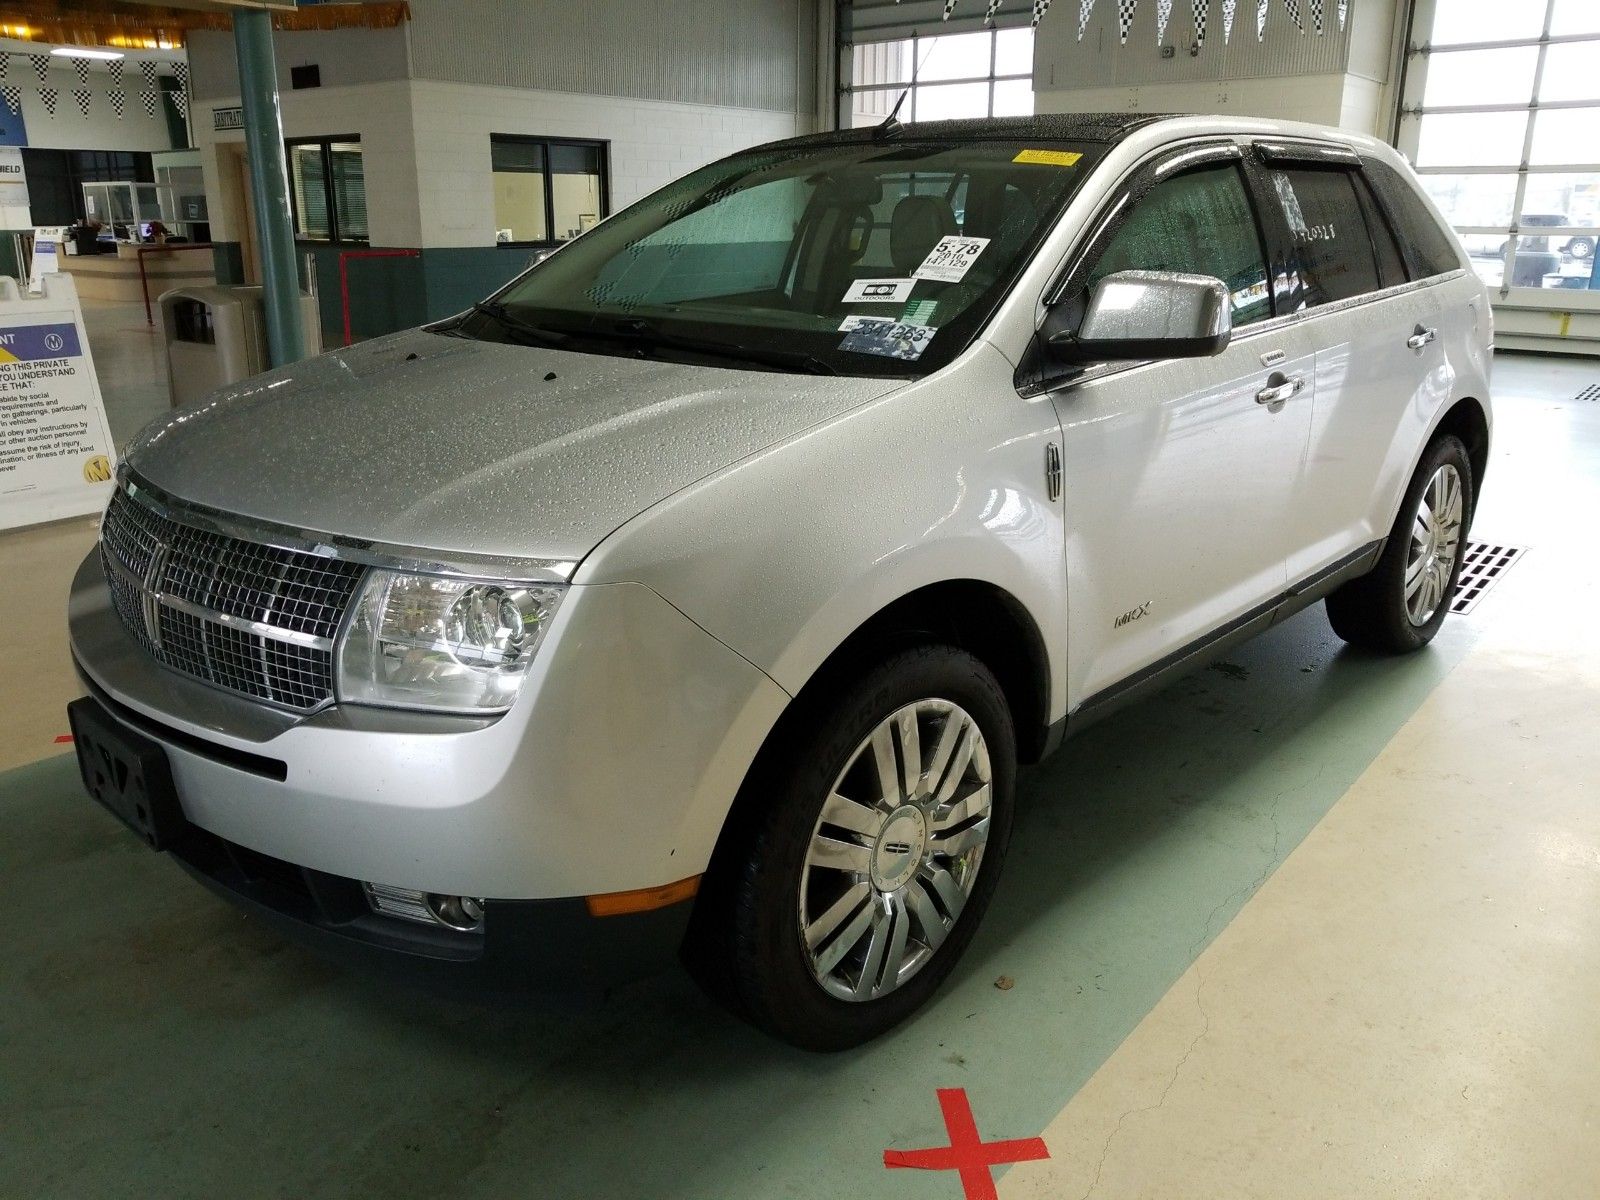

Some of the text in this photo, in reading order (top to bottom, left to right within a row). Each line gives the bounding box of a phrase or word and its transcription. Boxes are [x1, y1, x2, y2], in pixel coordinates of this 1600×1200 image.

[938, 252, 964, 260] 2010
[11, 362, 32, 371] THIS
[33, 358, 70, 370] PRIVATE
[18, 367, 76, 380] UNDERSTAND
[10, 381, 36, 391] THAT:
[0, 392, 49, 403] abide by social
[0, 398, 59, 412] requirements and
[51, 403, 88, 414] particularly
[9, 418, 38, 426] vehicles
[7, 428, 24, 438] obey
[25, 427, 38, 436] any
[39, 423, 79, 433] instructions
[79, 421, 88, 430] by
[8, 436, 26, 445] other
[27, 432, 53, 442] auction
[54, 429, 87, 440] personnel
[0, 448, 26, 456] assume
[27, 445, 38, 453] the
[39, 443, 52, 451] risk
[35, 450, 58, 460] illness
[66, 446, 79, 455] any
[80, 444, 95, 453] kind
